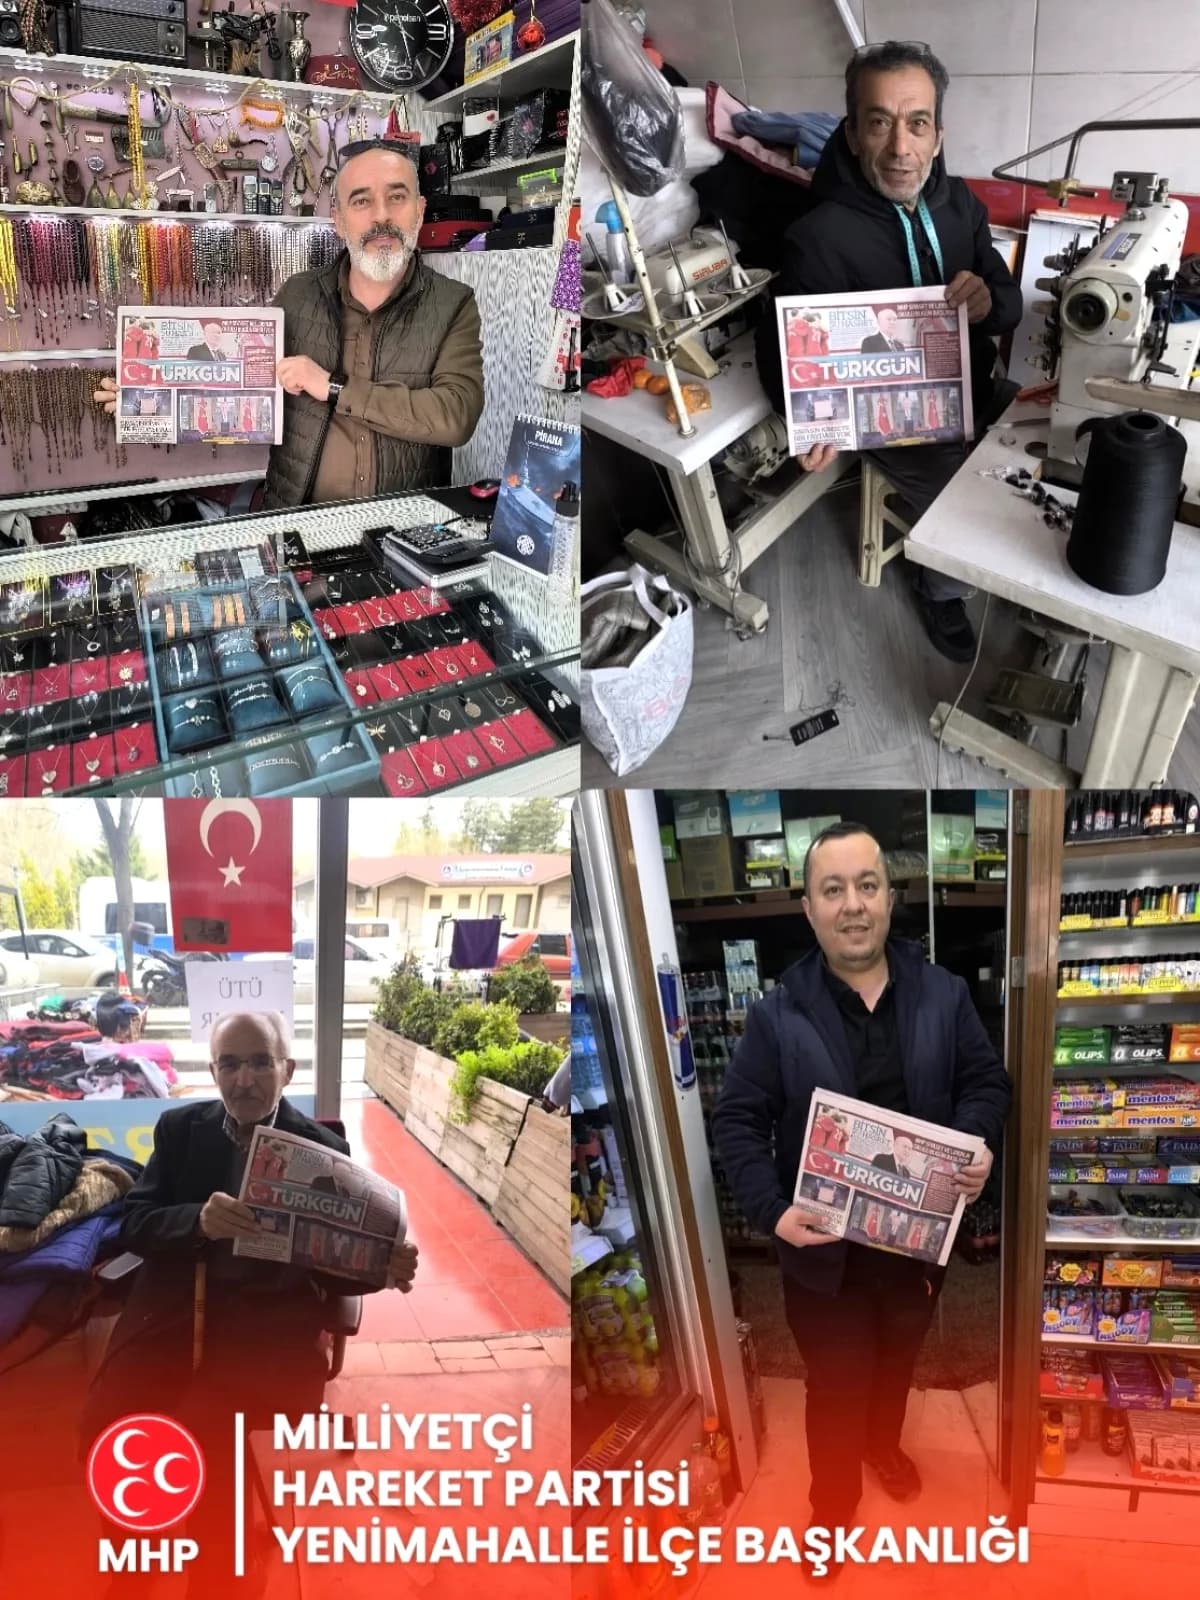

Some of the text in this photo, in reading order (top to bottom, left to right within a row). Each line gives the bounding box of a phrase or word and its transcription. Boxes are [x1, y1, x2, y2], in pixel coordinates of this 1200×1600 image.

[148, 364, 241, 382] TÜRKGÜN
[820, 356, 921, 381] TÜRKGÜN
[1056, 1099, 1093, 1109] mentos
[1127, 1094, 1176, 1105] mentos
[1056, 1118, 1100, 1126] mentos
[1127, 1116, 1176, 1125] mentos
[832, 1158, 921, 1203] TÜRKGÜN
[271, 1187, 363, 1223] TÜRKGÜN
